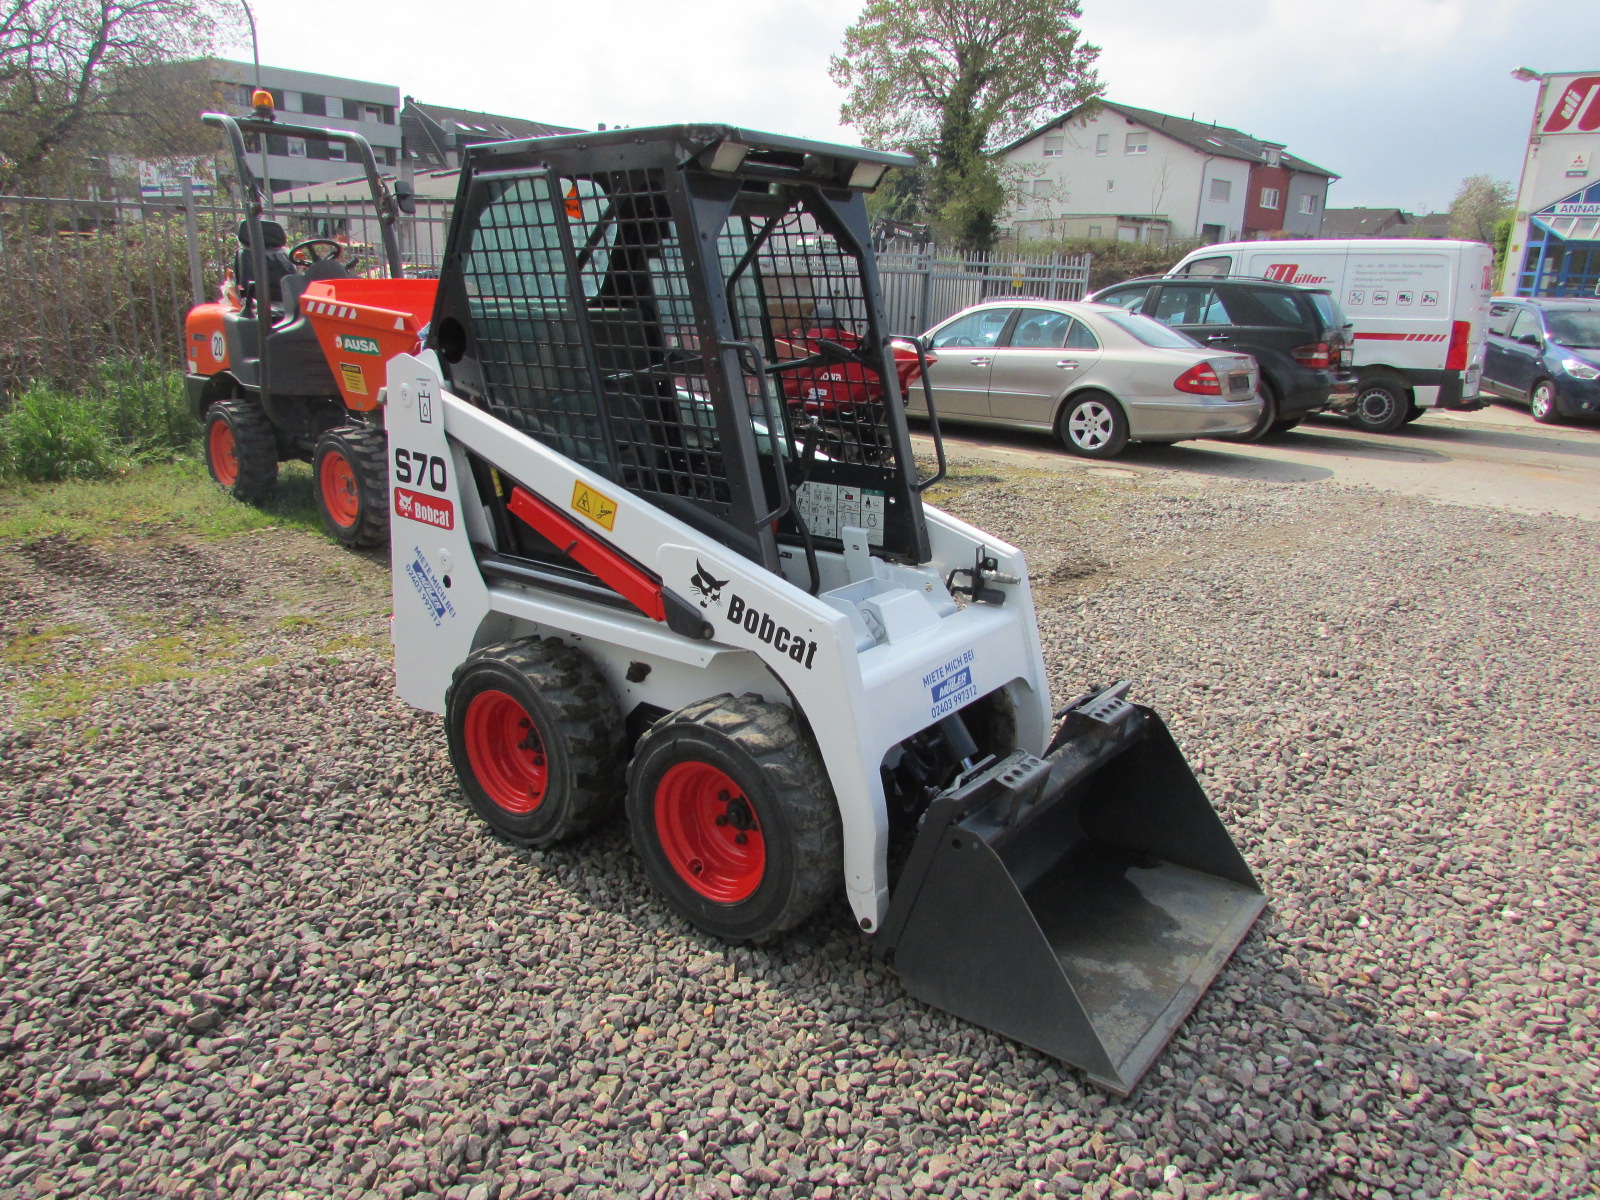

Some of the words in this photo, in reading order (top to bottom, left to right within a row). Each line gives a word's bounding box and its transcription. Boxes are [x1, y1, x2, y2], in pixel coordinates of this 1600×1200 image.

[214, 336, 223, 356] 20
[344, 338, 379, 352] AUSA
[395, 447, 447, 492] S70
[414, 502, 450, 527] Bobcat
[405, 564, 423, 593] 02403
[422, 593, 442, 628] 997312
[414, 546, 433, 575] MIETE
[431, 574, 447, 601] MICH
[445, 600, 457, 618] BEI
[727, 594, 818, 670] Bobcat
[922, 667, 944, 688] MIETE
[945, 656, 963, 675] MICH
[963, 649, 975, 663] BEI
[931, 699, 953, 718] 02403
[953, 685, 978, 706] 997312
